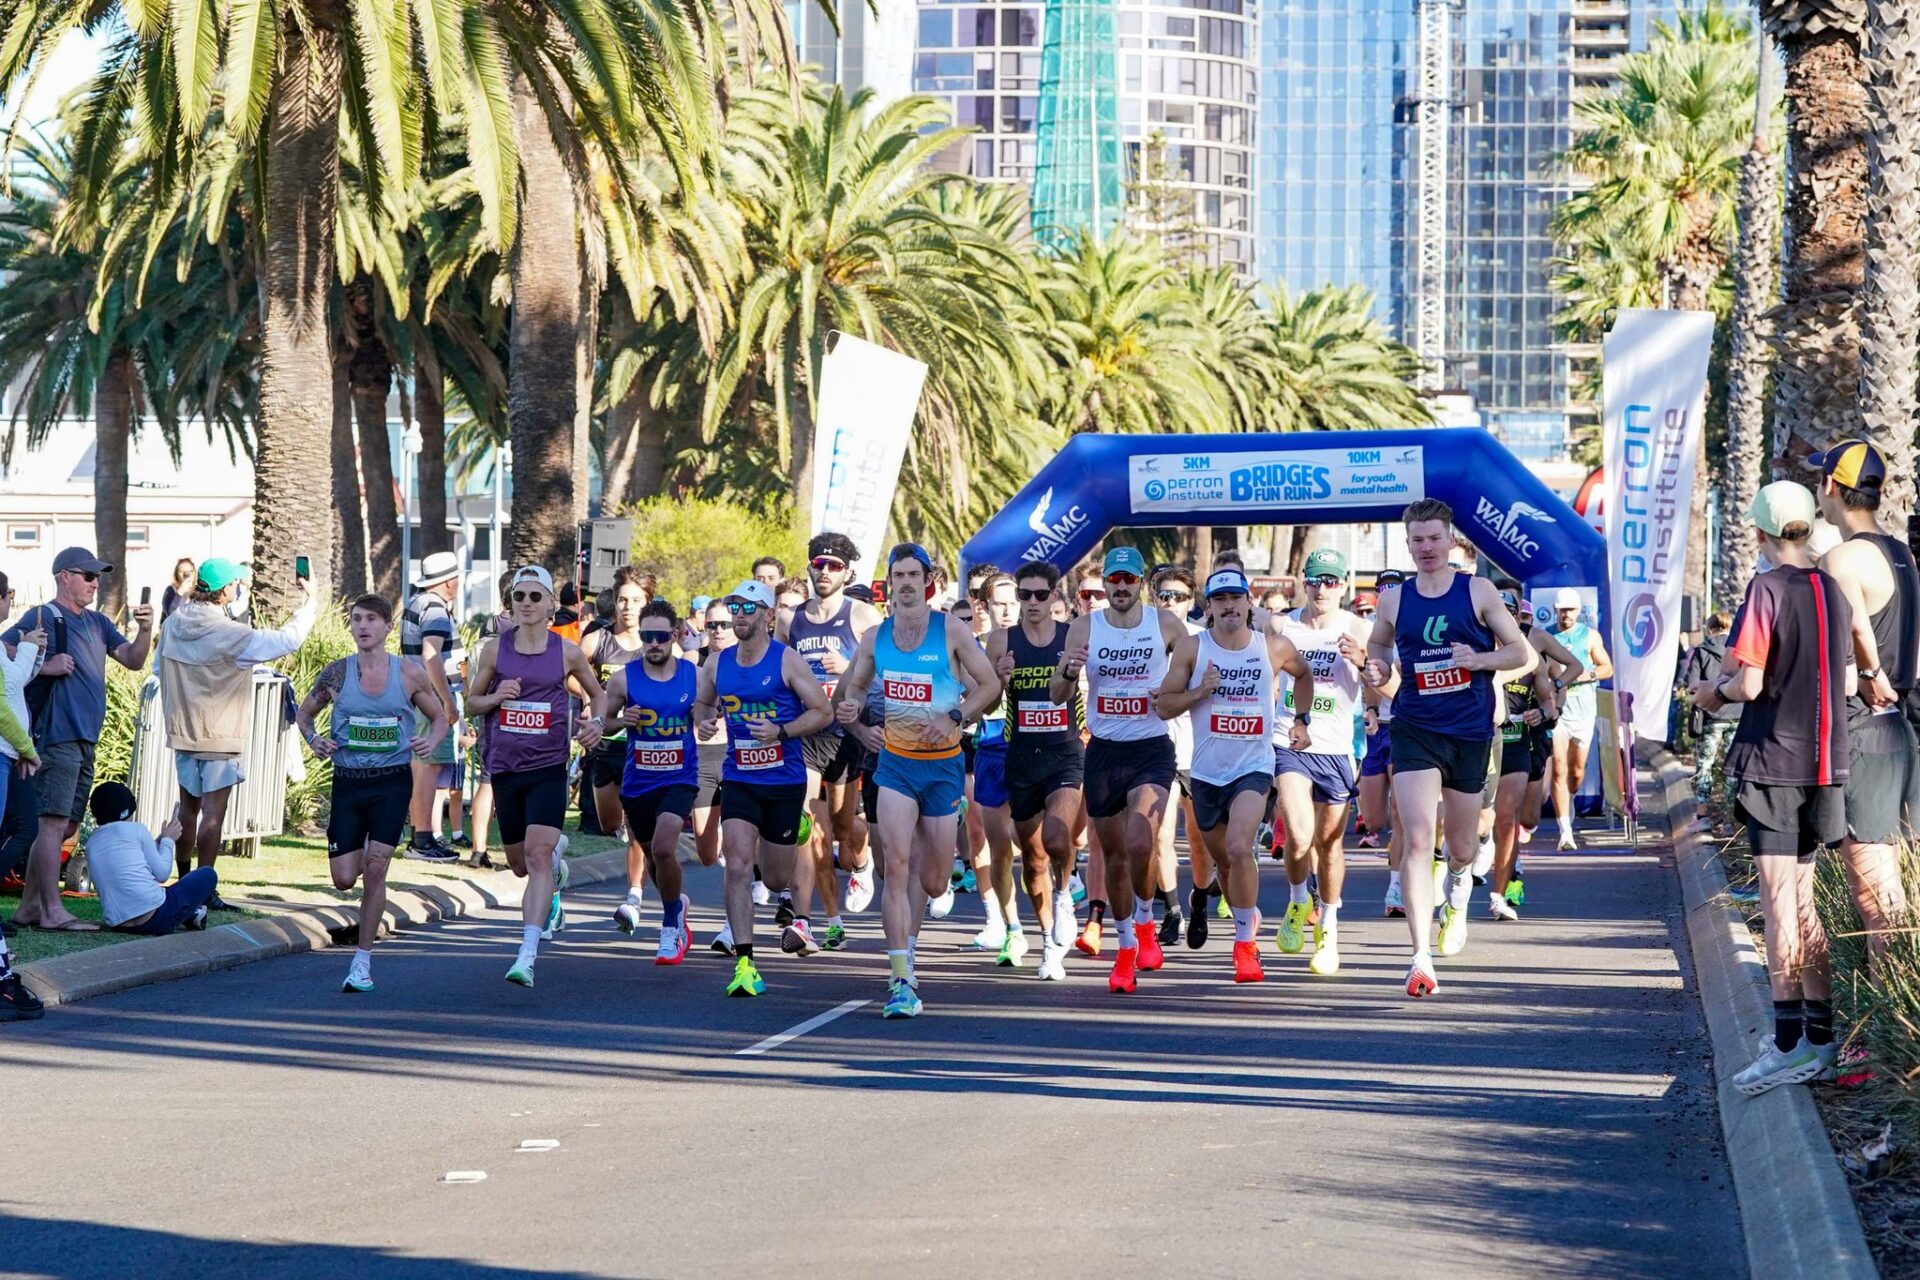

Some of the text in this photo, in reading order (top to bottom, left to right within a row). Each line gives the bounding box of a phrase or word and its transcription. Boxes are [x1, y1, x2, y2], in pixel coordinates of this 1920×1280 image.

[1183, 456, 1210, 469] 5KM
[1346, 451, 1381, 464] 10KM
[1168, 477, 1224, 491] perron
[1230, 464, 1332, 502] BRIDGES
[1351, 473, 1396, 485] for youth
[1168, 490, 1224, 501] institute
[1255, 486, 1312, 502] FUN RUN
[1340, 483, 1408, 495] mental health
[1622, 404, 1652, 584] perron
[1648, 407, 1688, 585] institute
[1021, 505, 1088, 561] WAMC
[1475, 495, 1540, 559] WAMC
[796, 636, 841, 653] PORTLAND
[1420, 647, 1453, 657] RUNNIN
[1098, 646, 1153, 661] Ogging
[1012, 666, 1058, 678] FRON
[1424, 669, 1462, 688] E011
[889, 683, 926, 700] E006
[1013, 678, 1050, 690] RUNN
[1104, 699, 1141, 713] E010
[506, 711, 545, 727] E008
[637, 709, 689, 737] RUN
[1025, 712, 1061, 725] E015
[1217, 717, 1258, 733] E007
[353, 727, 395, 740] 10826
[641, 751, 678, 764] E020
[740, 748, 778, 763] E009
